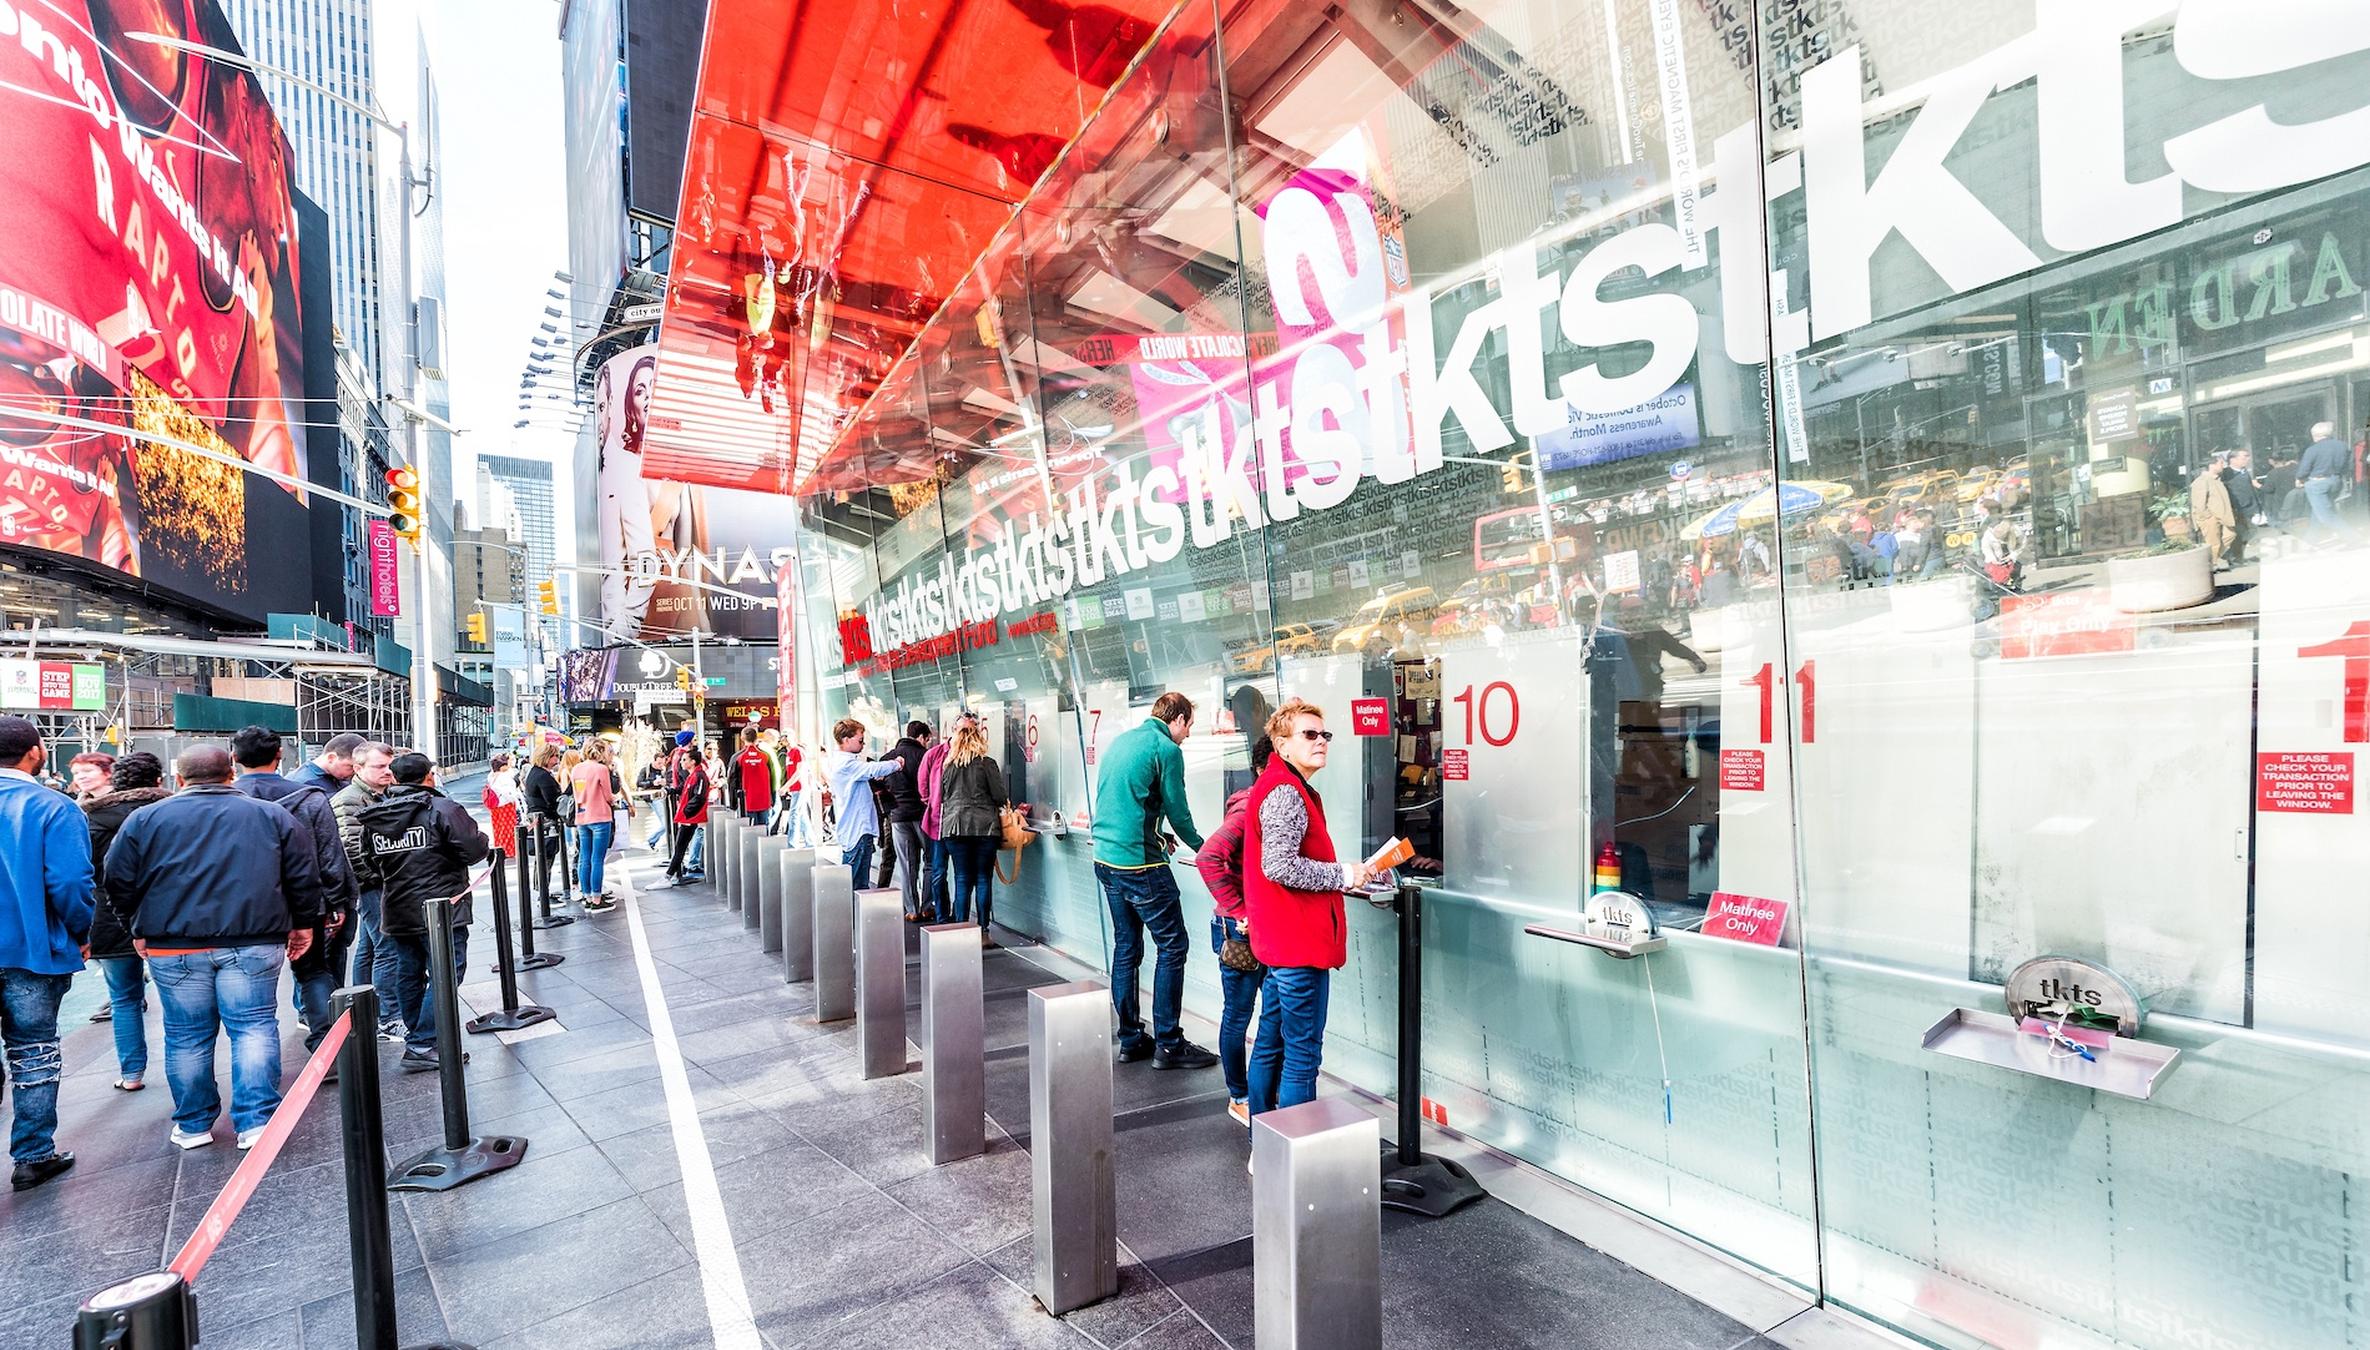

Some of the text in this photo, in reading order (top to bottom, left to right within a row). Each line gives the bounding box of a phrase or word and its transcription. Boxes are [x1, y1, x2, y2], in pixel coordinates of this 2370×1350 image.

[117, 112, 211, 260] Wants
[213, 234, 231, 286] It
[233, 265, 259, 321] All
[631, 308, 648, 318] city
[0, 444, 87, 484] Wants
[674, 597, 693, 611] OCT
[696, 597, 707, 611] 11
[710, 596, 738, 611] WED
[42, 671, 71, 682] STEP
[42, 689, 71, 698] GAME
[1739, 660, 1815, 744] 11
[726, 706, 770, 718] WELLS
[1356, 705, 1384, 715] Matinee
[1454, 681, 1519, 747] 10
[1089, 709, 1102, 745] 7
[1362, 716, 1379, 727] Only
[1028, 714, 1039, 746] 6
[2281, 754, 2329, 762] PLEASE
[2265, 763, 2347, 772] CHECK YOUR
[2262, 773, 2350, 781] TRANSACTION
[2275, 782, 2335, 790] PRIOR TO
[2265, 791, 2345, 800] LEAVING THE
[2276, 800, 2333, 809] WINDOW.
[375, 829, 422, 851] SECURITY
[1602, 905, 1633, 924] tkts
[1720, 900, 1776, 921] Matinee
[1725, 918, 1759, 936] Only
[2040, 978, 2102, 1006] tkts
